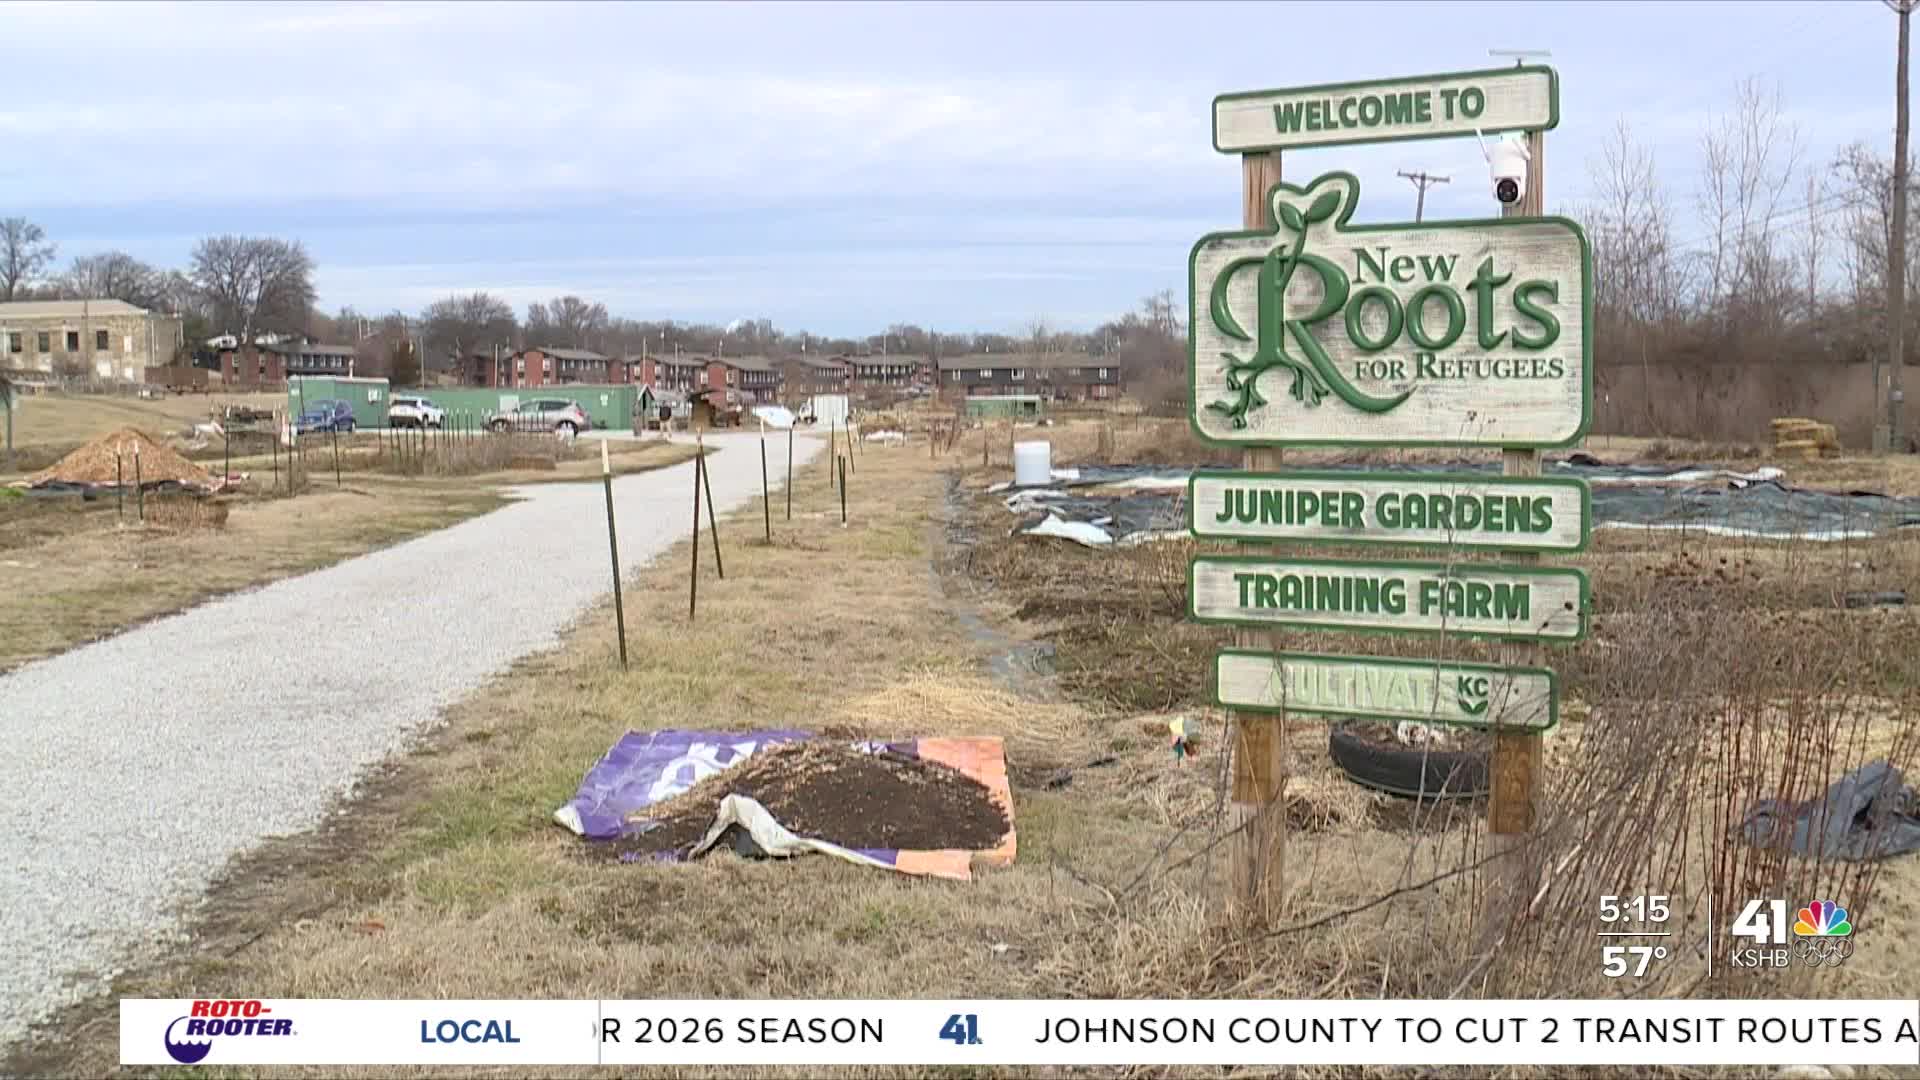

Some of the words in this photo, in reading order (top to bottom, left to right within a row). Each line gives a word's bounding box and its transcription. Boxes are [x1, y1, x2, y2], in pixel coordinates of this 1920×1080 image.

[1273, 93, 1432, 134] WELCOME
[1440, 87, 1486, 118] TO
[1352, 247, 1459, 282] New
[1208, 248, 1561, 415] Roots
[1355, 361, 1406, 380] FOR
[1416, 353, 1564, 380] REFUGEES
[1215, 488, 1366, 529] JUNIPER
[1375, 492, 1553, 532] GARDENS
[1233, 573, 1406, 614] TRAINING
[1418, 579, 1531, 621] FARM
[1270, 663, 1444, 712] CULTIVAT
[1457, 675, 1489, 697] KC
